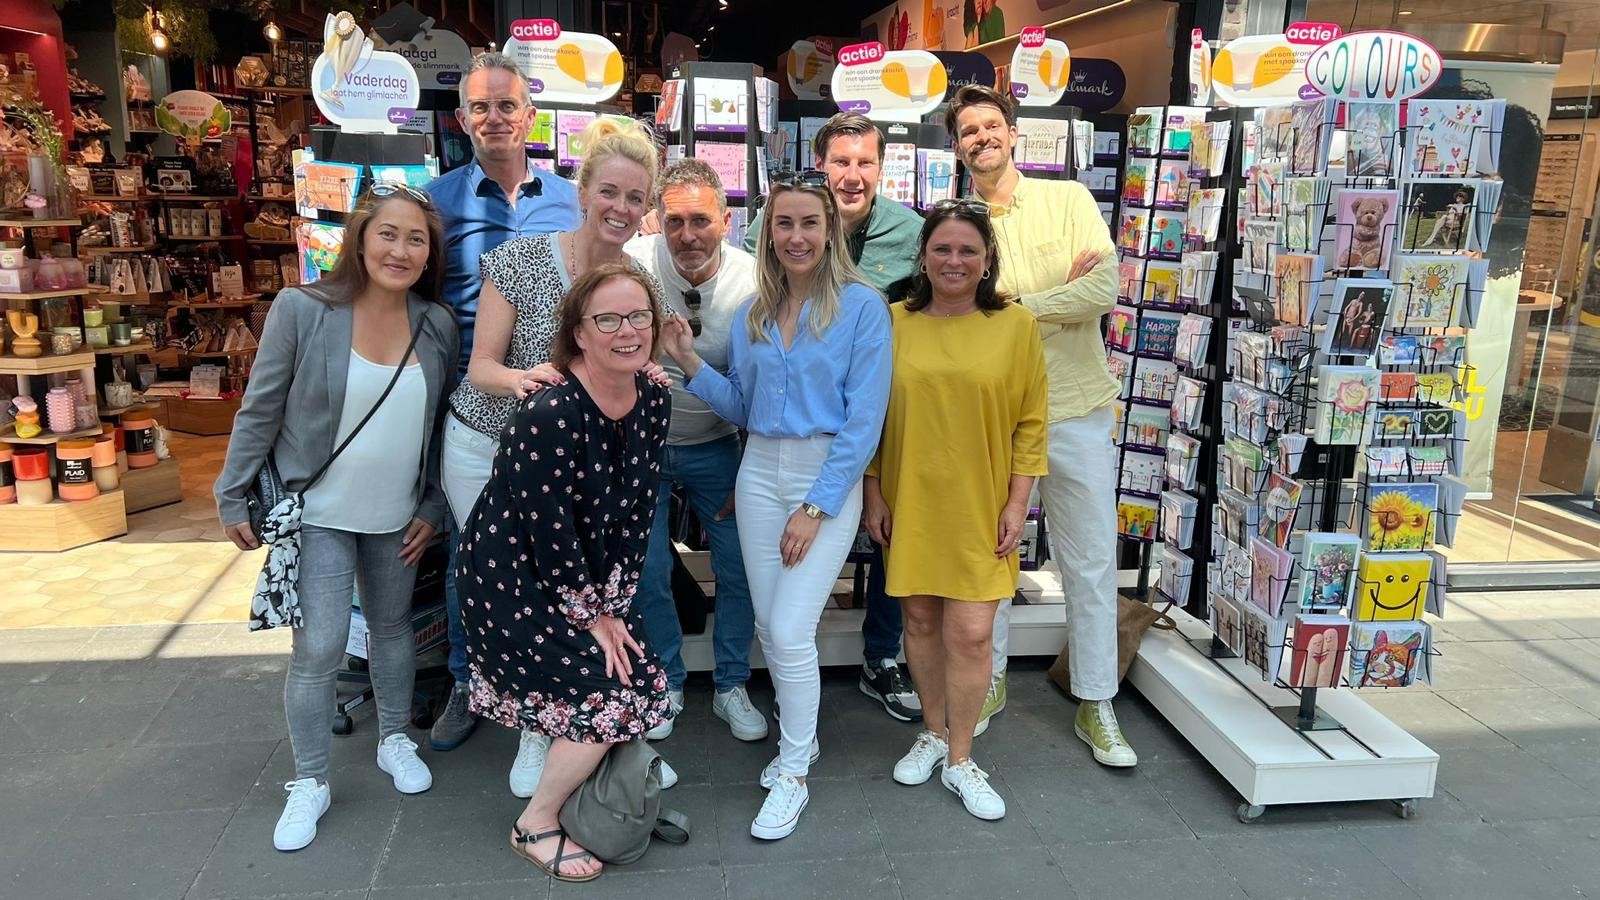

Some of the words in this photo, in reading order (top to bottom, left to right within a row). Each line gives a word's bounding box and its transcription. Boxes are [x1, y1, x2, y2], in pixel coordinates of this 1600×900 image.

[513, 22, 558, 37] actie!
[1022, 29, 1046, 44] actie!
[1287, 25, 1338, 40] actie!
[840, 45, 882, 63] actie!
[1315, 36, 1432, 99] COLOURS
[344, 73, 408, 92] Vaderdag
[330, 88, 347, 98] laat
[347, 89, 366, 98] hem
[367, 90, 408, 101] glimlachen
[65, 469, 85, 477] PLAID
